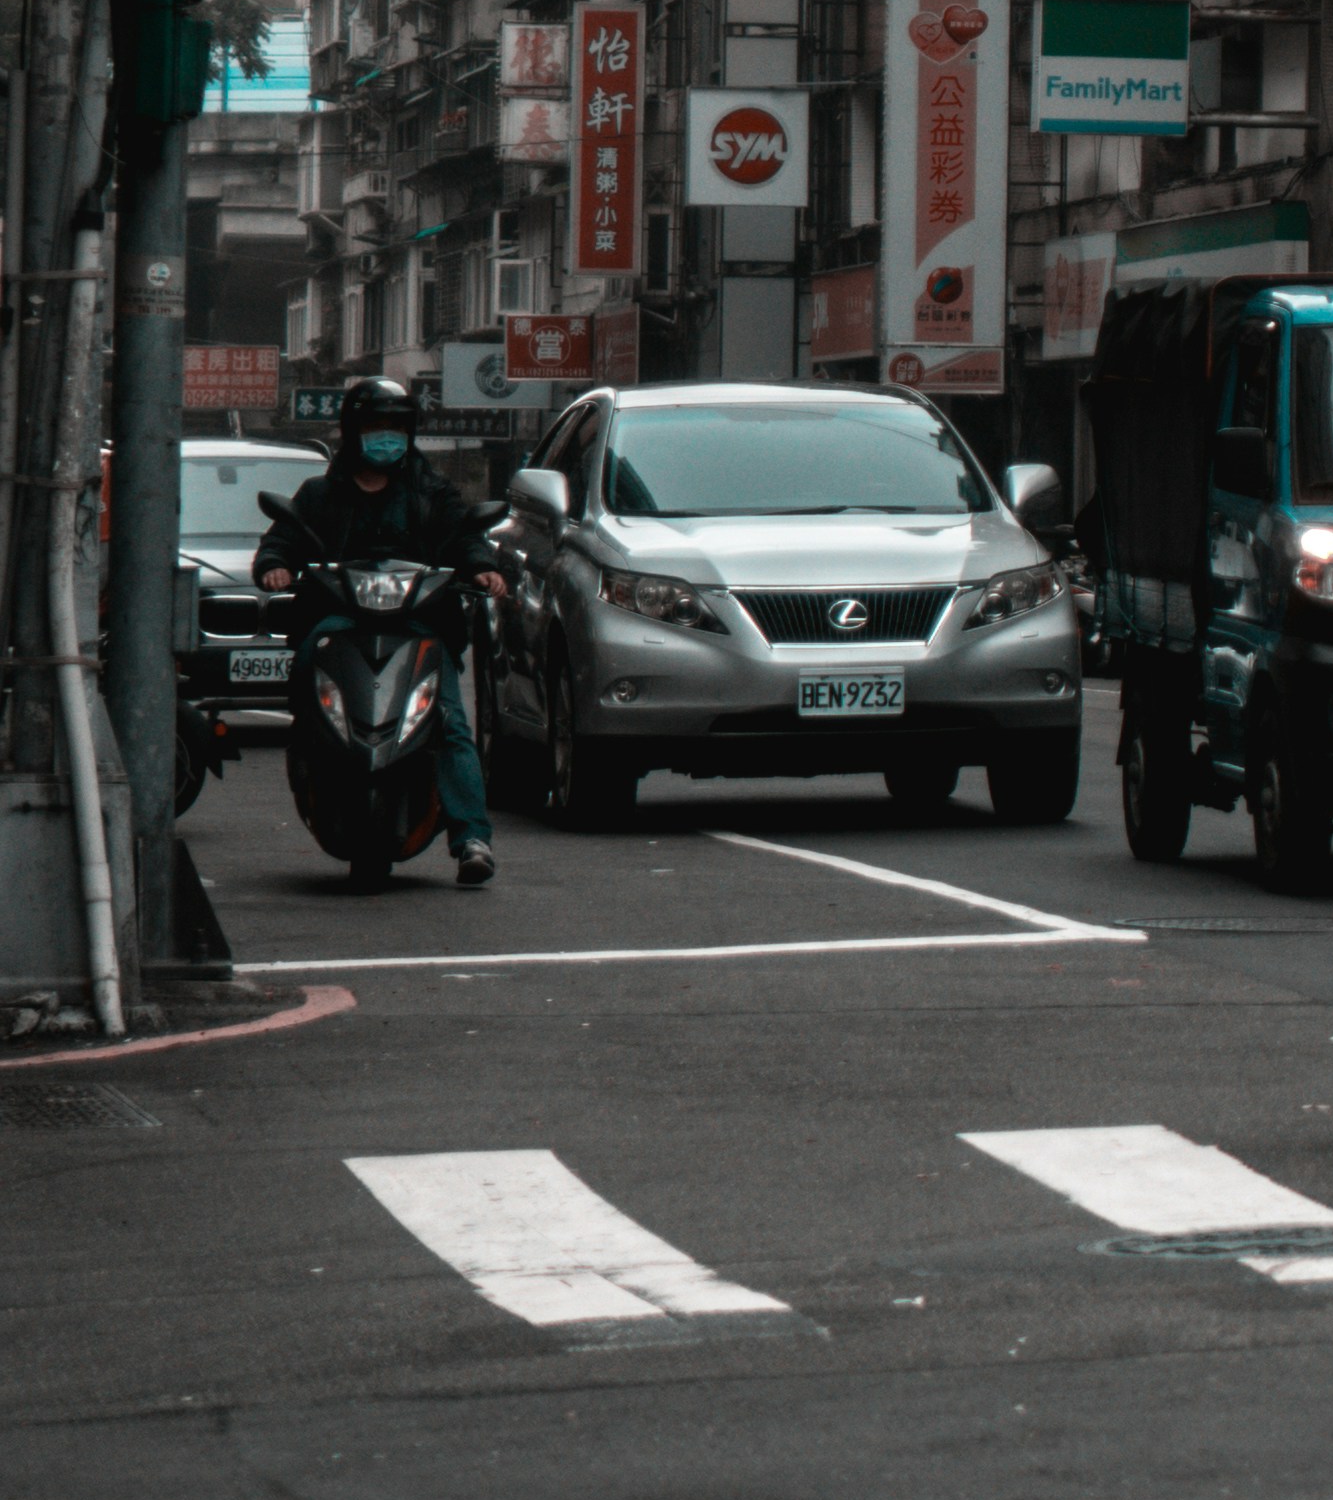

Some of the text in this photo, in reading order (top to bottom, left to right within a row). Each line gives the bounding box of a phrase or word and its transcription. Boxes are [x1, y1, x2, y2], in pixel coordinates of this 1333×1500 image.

[586, 26, 634, 135] 怡軒
[1046, 75, 1183, 105] FamilyMart
[708, 130, 788, 168] SYM
[929, 75, 965, 224] 公益彩券
[801, 681, 902, 709] BEN-9232
